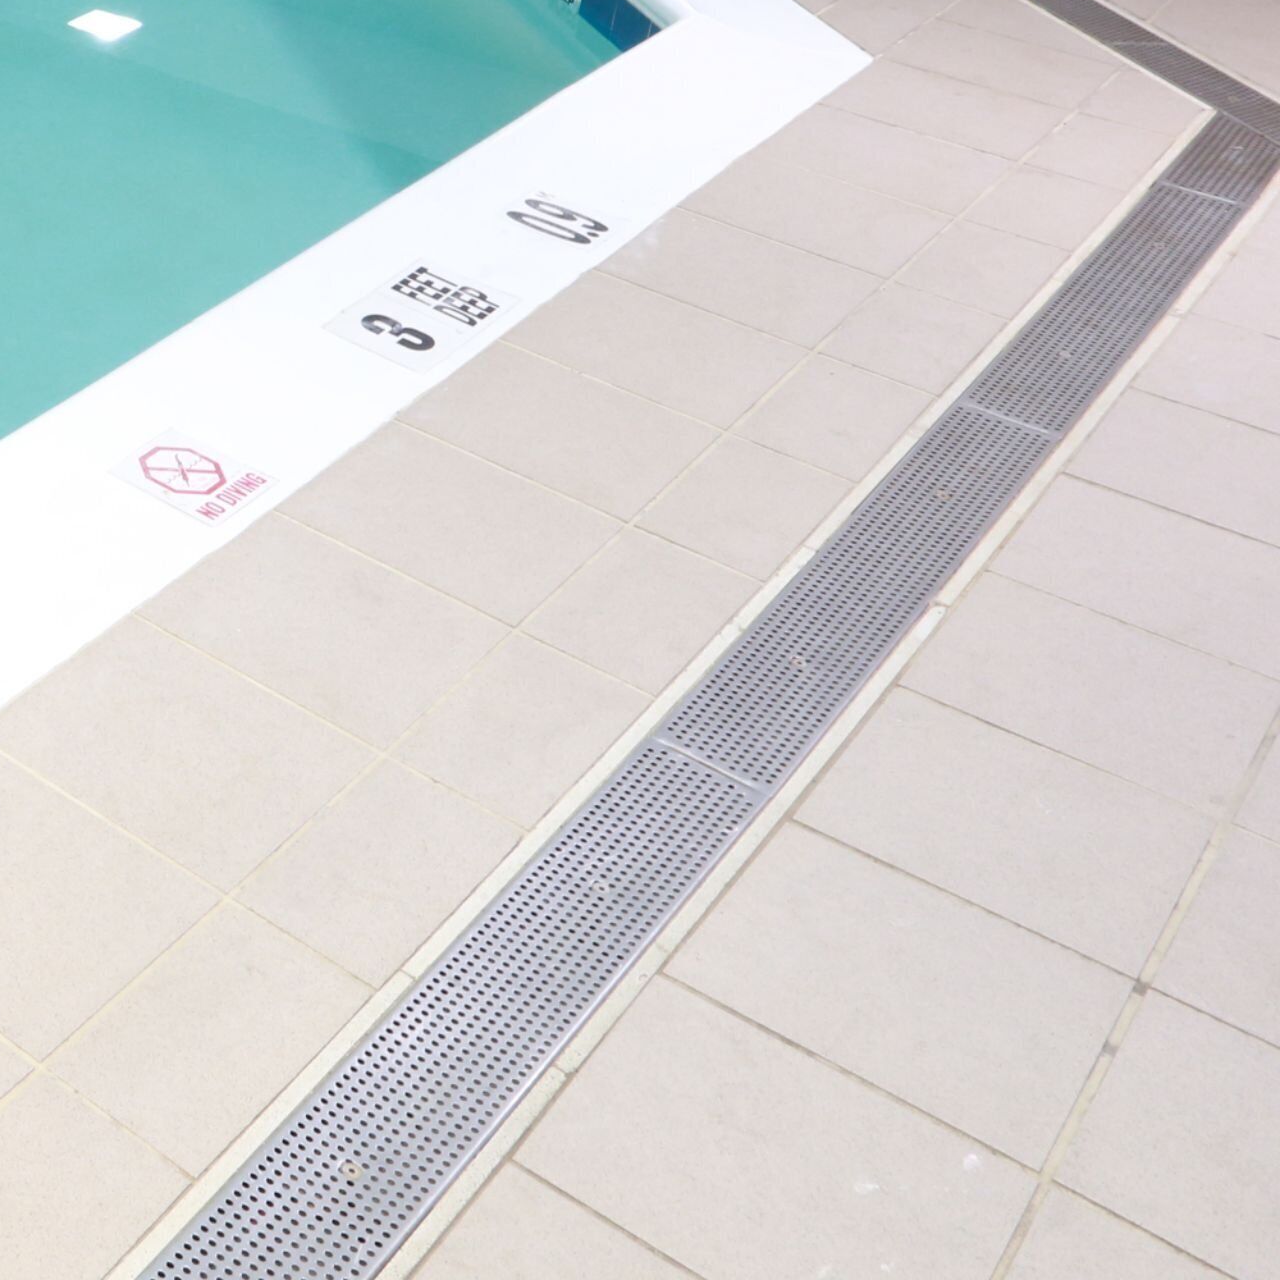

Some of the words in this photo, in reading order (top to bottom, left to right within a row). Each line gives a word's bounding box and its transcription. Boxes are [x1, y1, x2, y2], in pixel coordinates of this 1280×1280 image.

[390, 266, 458, 307] FEET
[433, 286, 500, 327] DEEP
[361, 314, 435, 352] 3
[195, 501, 227, 521] NO
[215, 471, 268, 507] DIVING
